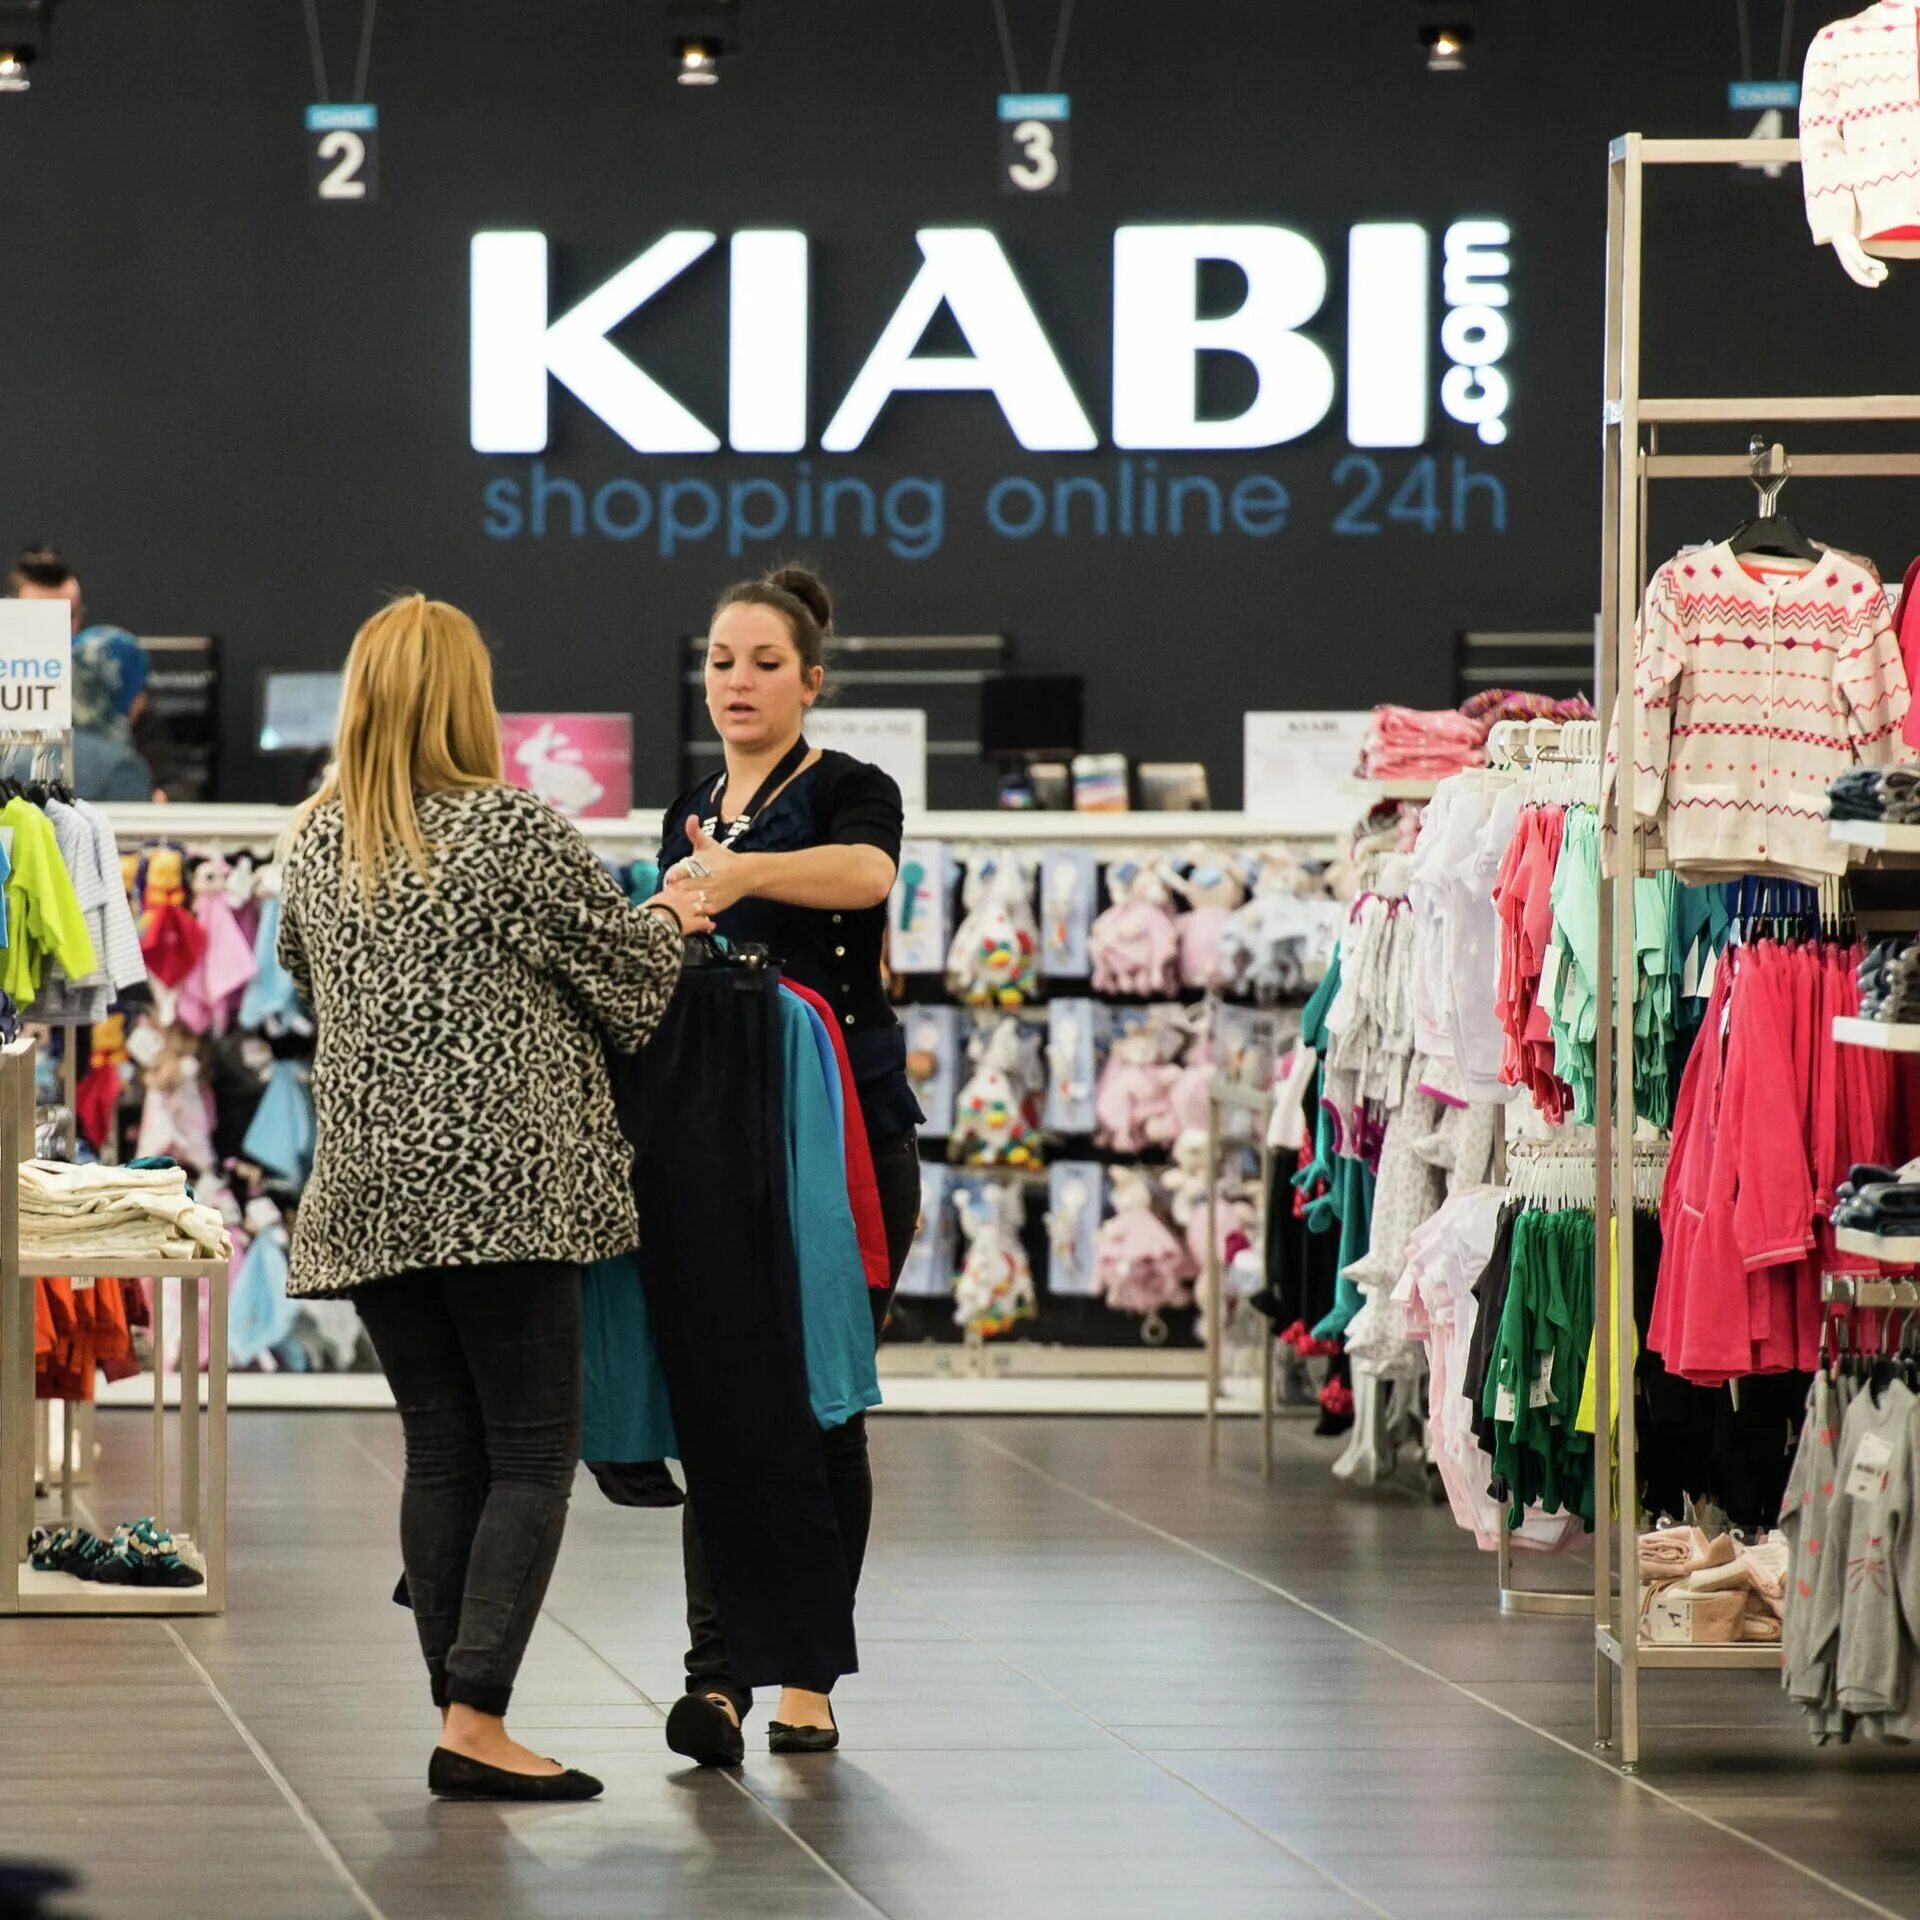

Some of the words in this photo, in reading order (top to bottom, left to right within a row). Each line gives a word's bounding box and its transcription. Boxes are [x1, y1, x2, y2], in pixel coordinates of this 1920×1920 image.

[318, 130, 366, 199] 2
[1008, 120, 1058, 191] 3
[1738, 108, 1789, 178] 4
[471, 223, 1428, 453] KIABI
[1441, 220, 1511, 445] .com
[484, 461, 944, 559] shopping
[986, 458, 1289, 537] online
[1333, 455, 1506, 534] 24h
